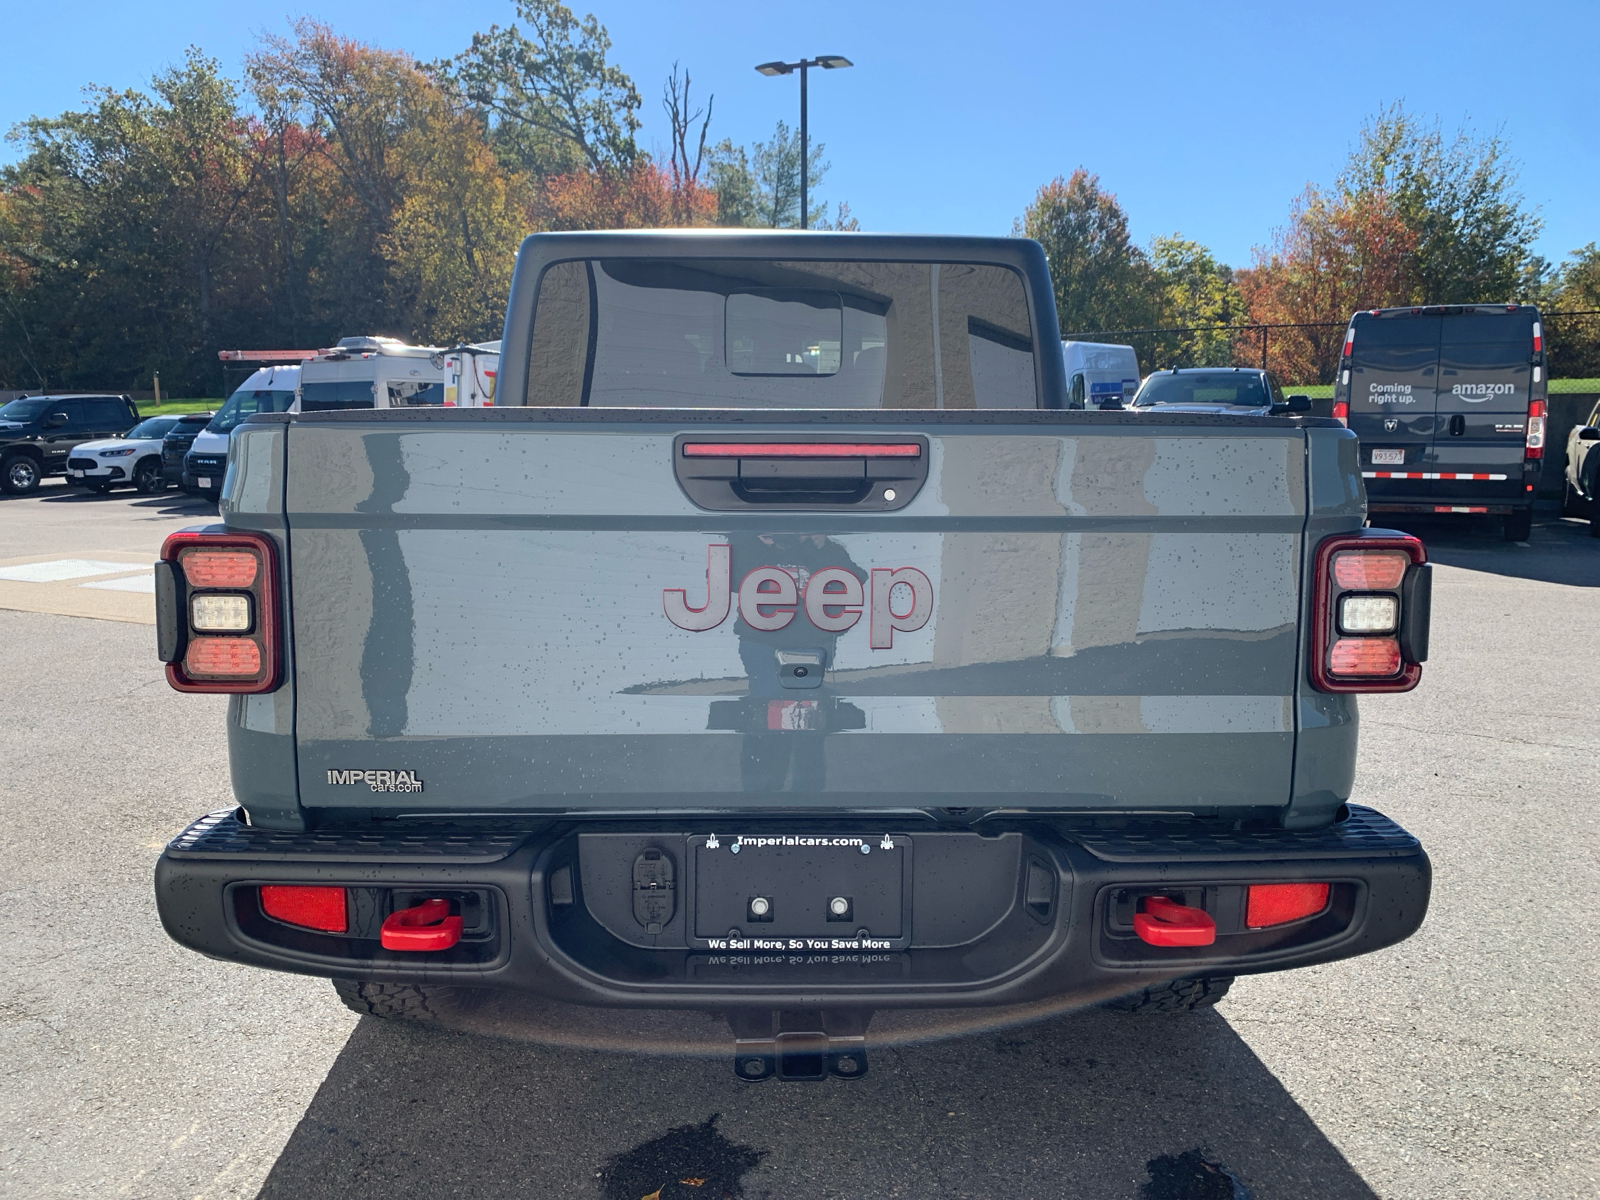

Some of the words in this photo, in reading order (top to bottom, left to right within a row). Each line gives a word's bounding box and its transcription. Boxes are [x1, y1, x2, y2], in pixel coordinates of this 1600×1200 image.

[1369, 383, 1412, 394] Coming
[1452, 383, 1515, 395] amazon
[1368, 394, 1397, 404] right
[1399, 395, 1416, 404] up.
[662, 543, 934, 650] Jeep
[327, 770, 423, 785] IMPERIAL
[370, 783, 423, 793] cars.com
[737, 836, 863, 847] Imperialcars.com
[708, 939, 727, 949] We
[729, 939, 750, 949] Sell
[754, 939, 785, 950] More,
[789, 939, 803, 949] So
[807, 939, 828, 949] You
[831, 939, 859, 949] Save
[862, 939, 891, 949] More
